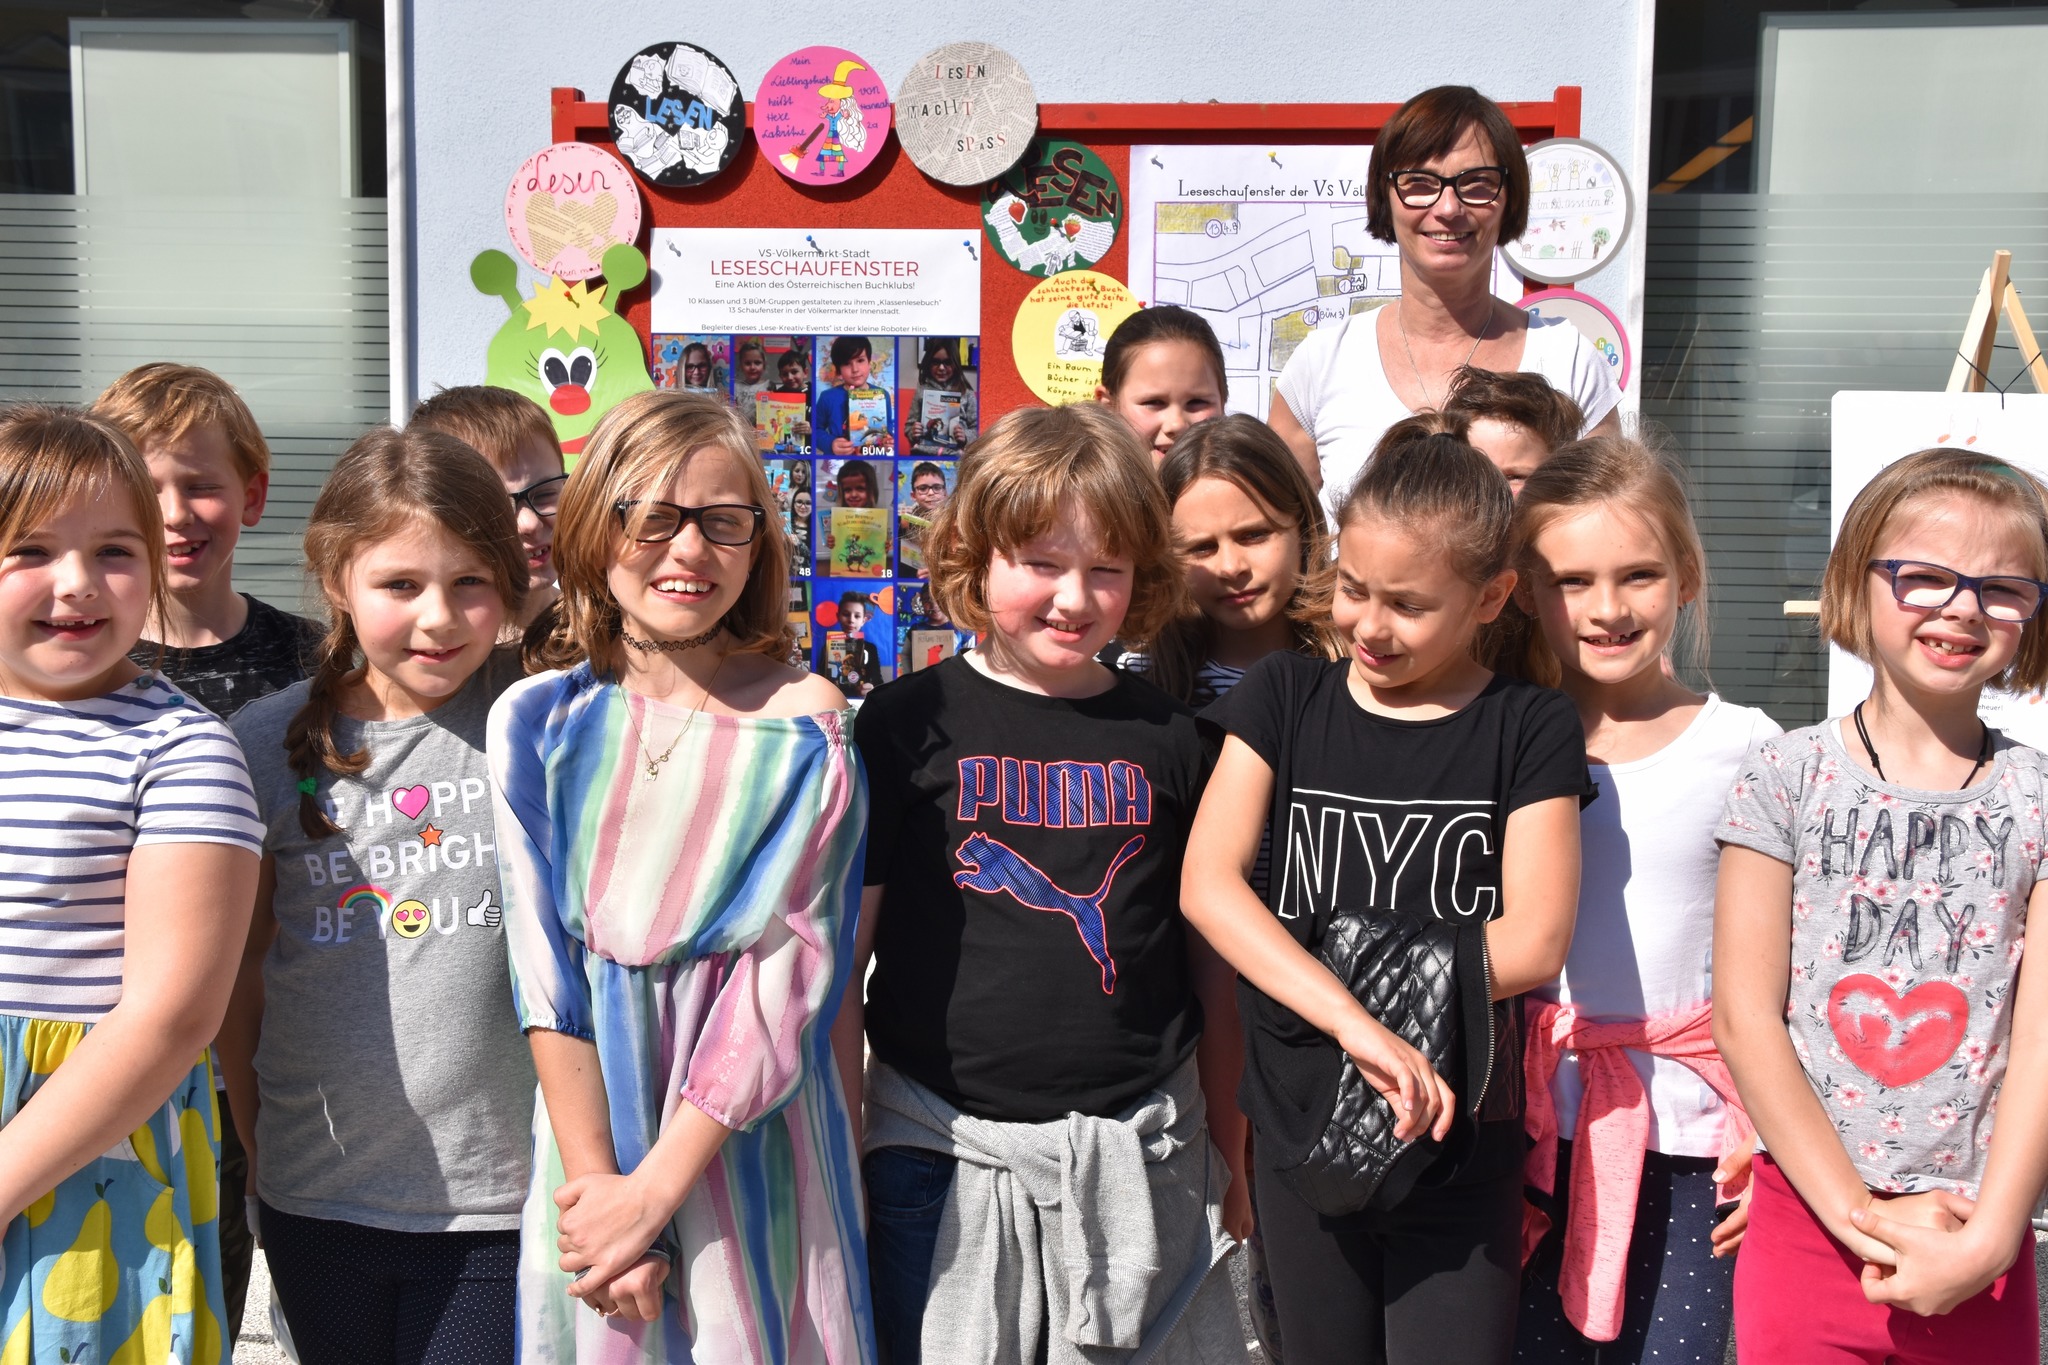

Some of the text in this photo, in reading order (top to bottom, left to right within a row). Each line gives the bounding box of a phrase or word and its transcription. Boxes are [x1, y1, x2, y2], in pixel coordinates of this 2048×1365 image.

[789, 57, 811, 65] Mein
[935, 65, 985, 80] LESEN
[771, 75, 832, 90] Lieblingsbuch
[859, 86, 881, 96] von
[768, 95, 794, 106] heißt
[645, 96, 713, 131] LESEN
[907, 99, 974, 118] MACHT
[957, 131, 1006, 152] SPASS
[527, 154, 611, 194] Lesen
[1178, 180, 1286, 201] Leseschaufenster
[1290, 184, 1308, 196] der
[758, 249, 870, 258] VS-Völkermarkt-Stadt
[711, 260, 919, 276] LESESCHAUFENSTER
[737, 280, 766, 288] Aktion
[769, 280, 784, 288] des
[787, 280, 862, 289] Österreichischen
[865, 281, 915, 290] Buchklubs!
[1038, 285, 1096, 294] schlechteste
[748, 297, 799, 307] BÜM-Gruppen
[802, 299, 842, 307] gestalteten
[1077, 294, 1098, 302] gute
[701, 324, 732, 332] Begleiter
[1066, 364, 1092, 372] Raum
[1048, 374, 1079, 382] Bücher
[1048, 386, 1076, 396] Körper
[800, 446, 811, 454] 1C
[862, 445, 894, 456] BÜM 2
[799, 567, 812, 576] 4B
[881, 569, 892, 578] 1B
[957, 756, 1152, 828] PUMA
[1820, 808, 2014, 888] HAPPY
[1278, 803, 1497, 922] NYC
[304, 851, 352, 886] BE
[312, 906, 354, 944] BE
[1841, 894, 1975, 972] DAY
